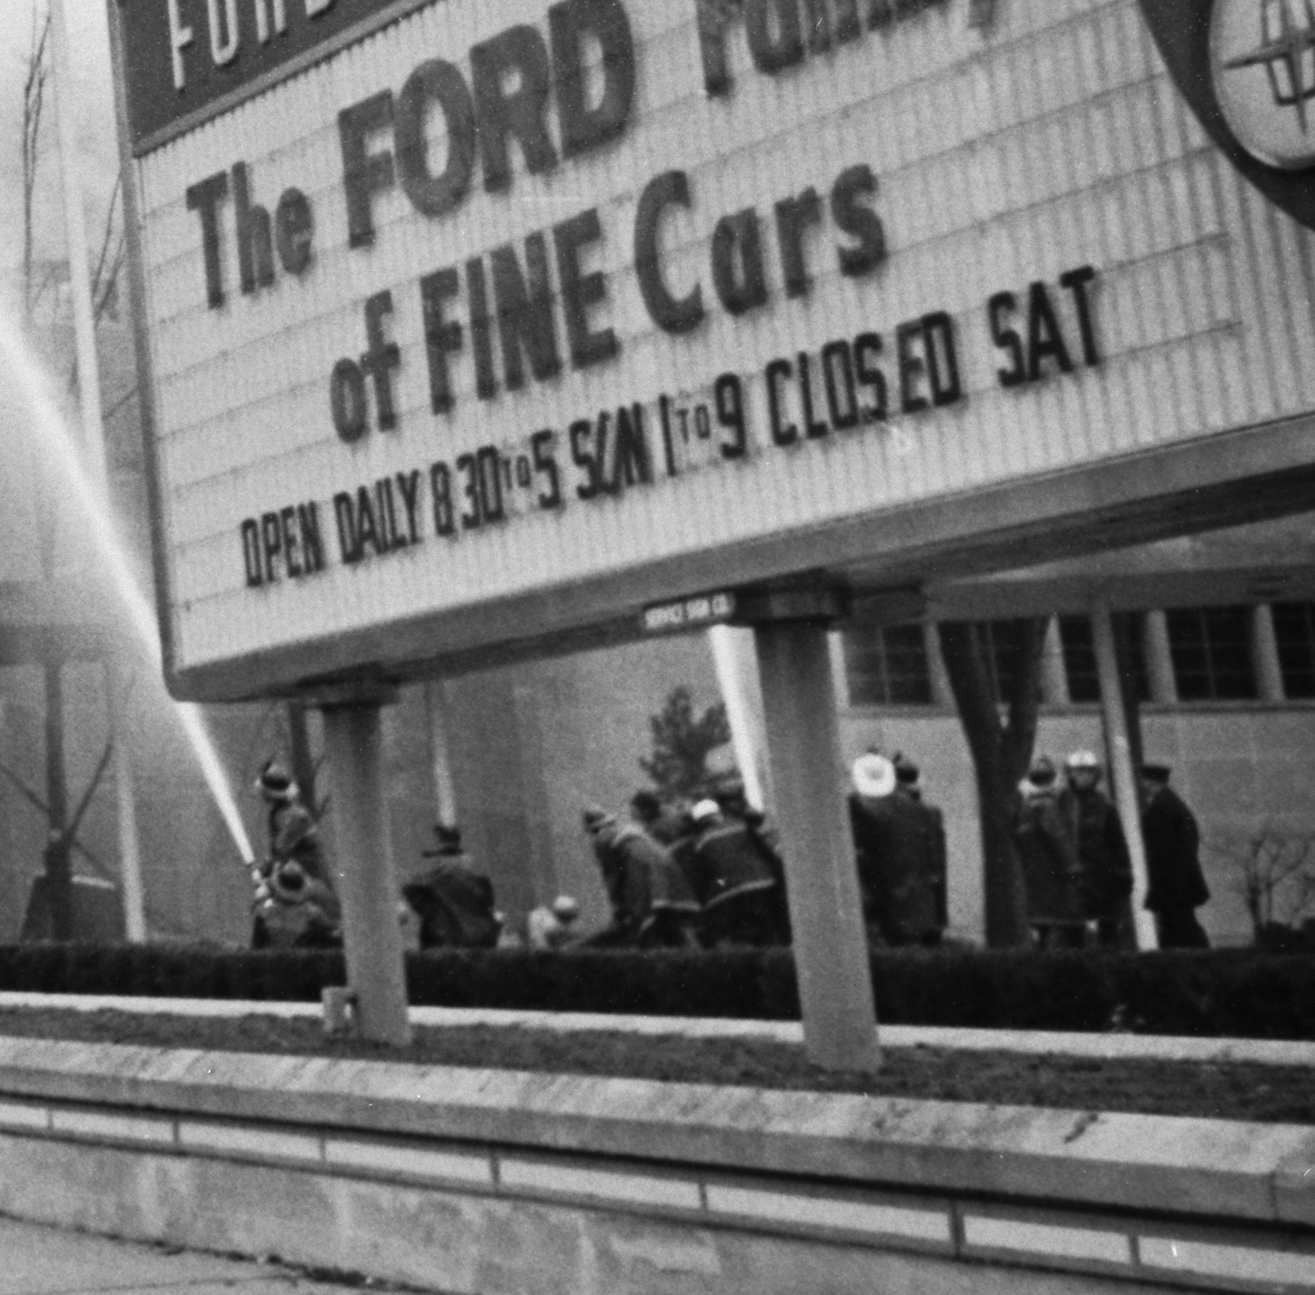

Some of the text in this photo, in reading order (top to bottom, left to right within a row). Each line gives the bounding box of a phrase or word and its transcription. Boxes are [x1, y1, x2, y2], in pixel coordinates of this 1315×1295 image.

[186, 161, 315, 310] The
[329, 164, 888, 444] of FINE Cars
[241, 501, 326, 588] OPEN
[333, 468, 421, 565] DAILY
[569, 401, 653, 500] SUN
[766, 310, 963, 447] CLOSED
[988, 265, 1098, 388] SAT
